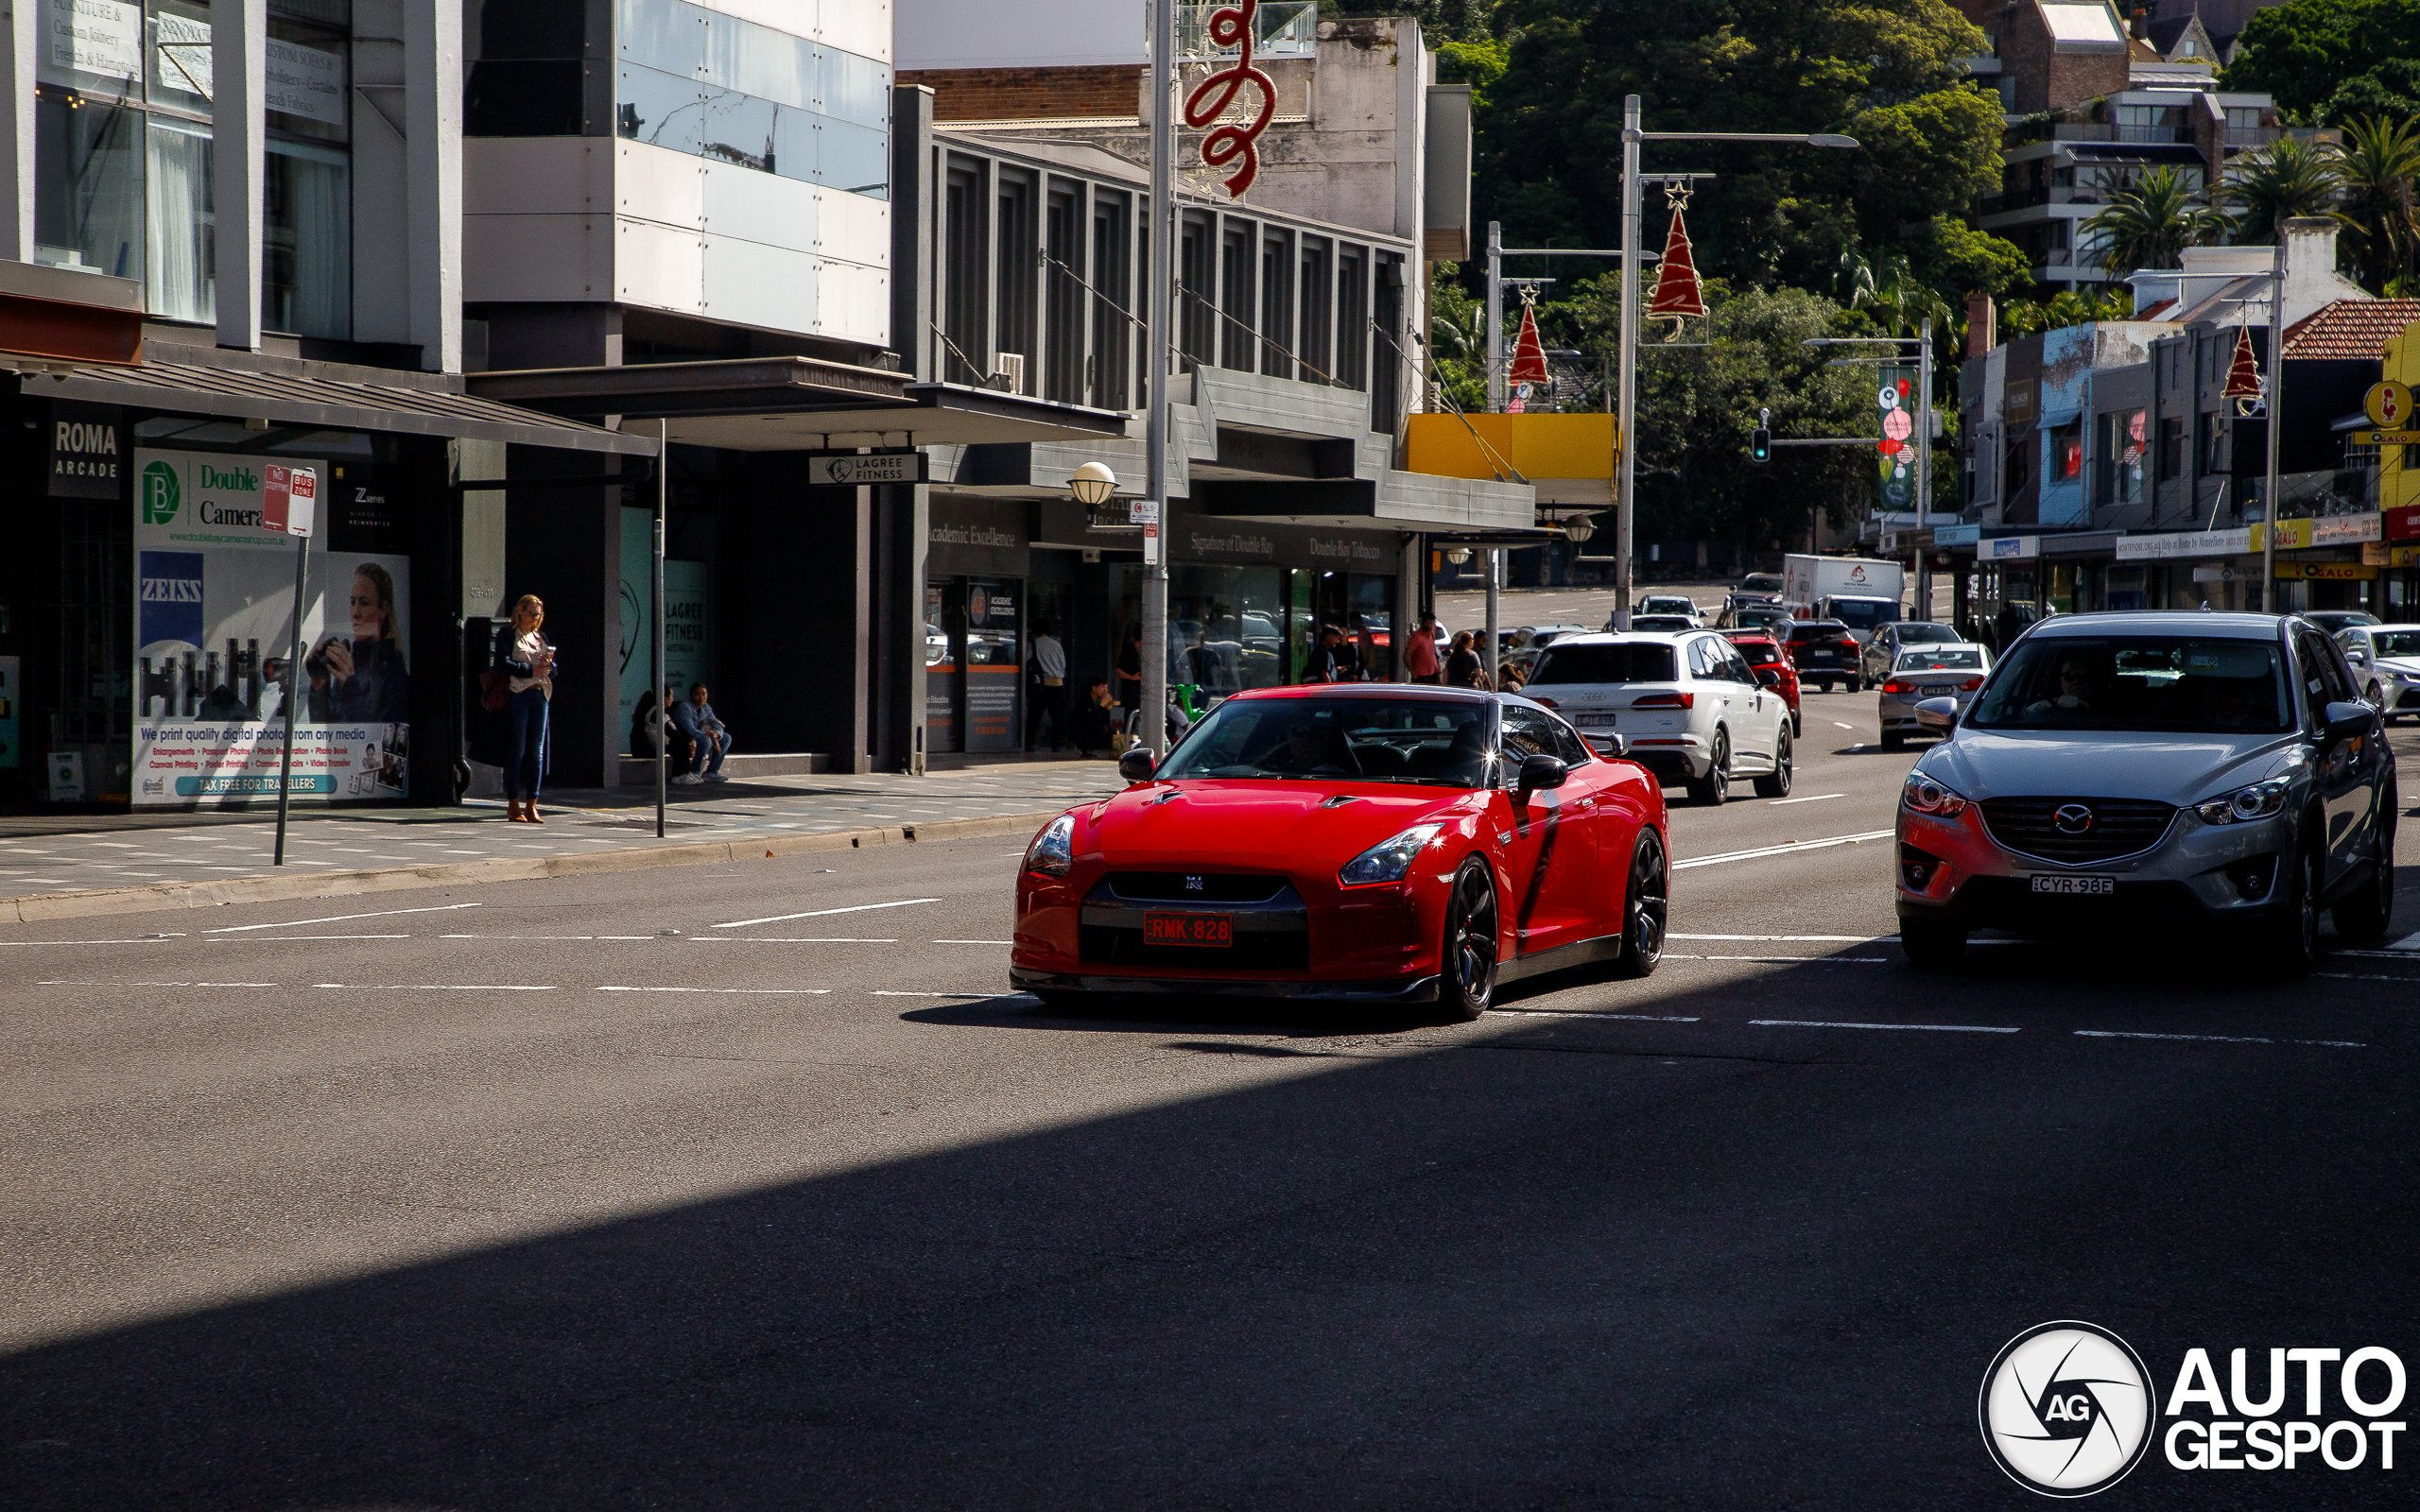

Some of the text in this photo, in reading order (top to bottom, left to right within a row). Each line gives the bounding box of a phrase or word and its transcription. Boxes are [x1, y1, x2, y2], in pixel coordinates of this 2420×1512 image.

[54, 0, 123, 23] FURNITURE &
[53, 19, 121, 51] Custom Joinery
[54, 44, 85, 64] French
[85, 51, 95, 66] &
[266, 43, 298, 63] USTOM
[266, 65, 301, 91] pholstery
[266, 92, 286, 107] rench
[56, 421, 117, 455] ROMA
[2371, 433, 2409, 443] OGALO
[56, 459, 117, 478] ARCADE
[856, 458, 903, 469] LAGREE
[200, 464, 258, 492] Double
[272, 470, 285, 481] NO
[294, 475, 313, 488] BUS
[856, 470, 903, 480] FITNESS
[265, 480, 290, 493] STOPPING
[294, 486, 312, 497] ZONE
[199, 500, 263, 527] Camera
[970, 525, 1015, 547] Excellence
[1191, 532, 1274, 558] Signature of Double Bay
[1310, 537, 1380, 561] Double Bay Tobacco
[2305, 564, 2354, 578] OGALO
[141, 577, 202, 603] ZEISS
[666, 601, 703, 620] LAGREE
[972, 596, 984, 613] AE
[666, 623, 703, 642] FITNESS
[141, 727, 366, 744] We print quality digital photo rom any media
[152, 747, 195, 758] Enlargements
[201, 747, 229, 757] Passport
[230, 747, 251, 756] Photos
[315, 747, 332, 755] Photo
[333, 747, 349, 755] Book
[148, 761, 173, 769] Canvas
[174, 760, 199, 770] Printing
[205, 760, 224, 768] Poster
[225, 760, 249, 769] Printing
[255, 760, 280, 768] Camera
[310, 759, 327, 767] Video
[328, 759, 352, 767] Transfer
[199, 777, 316, 792] TAX FREE FOR TRAELLERS
